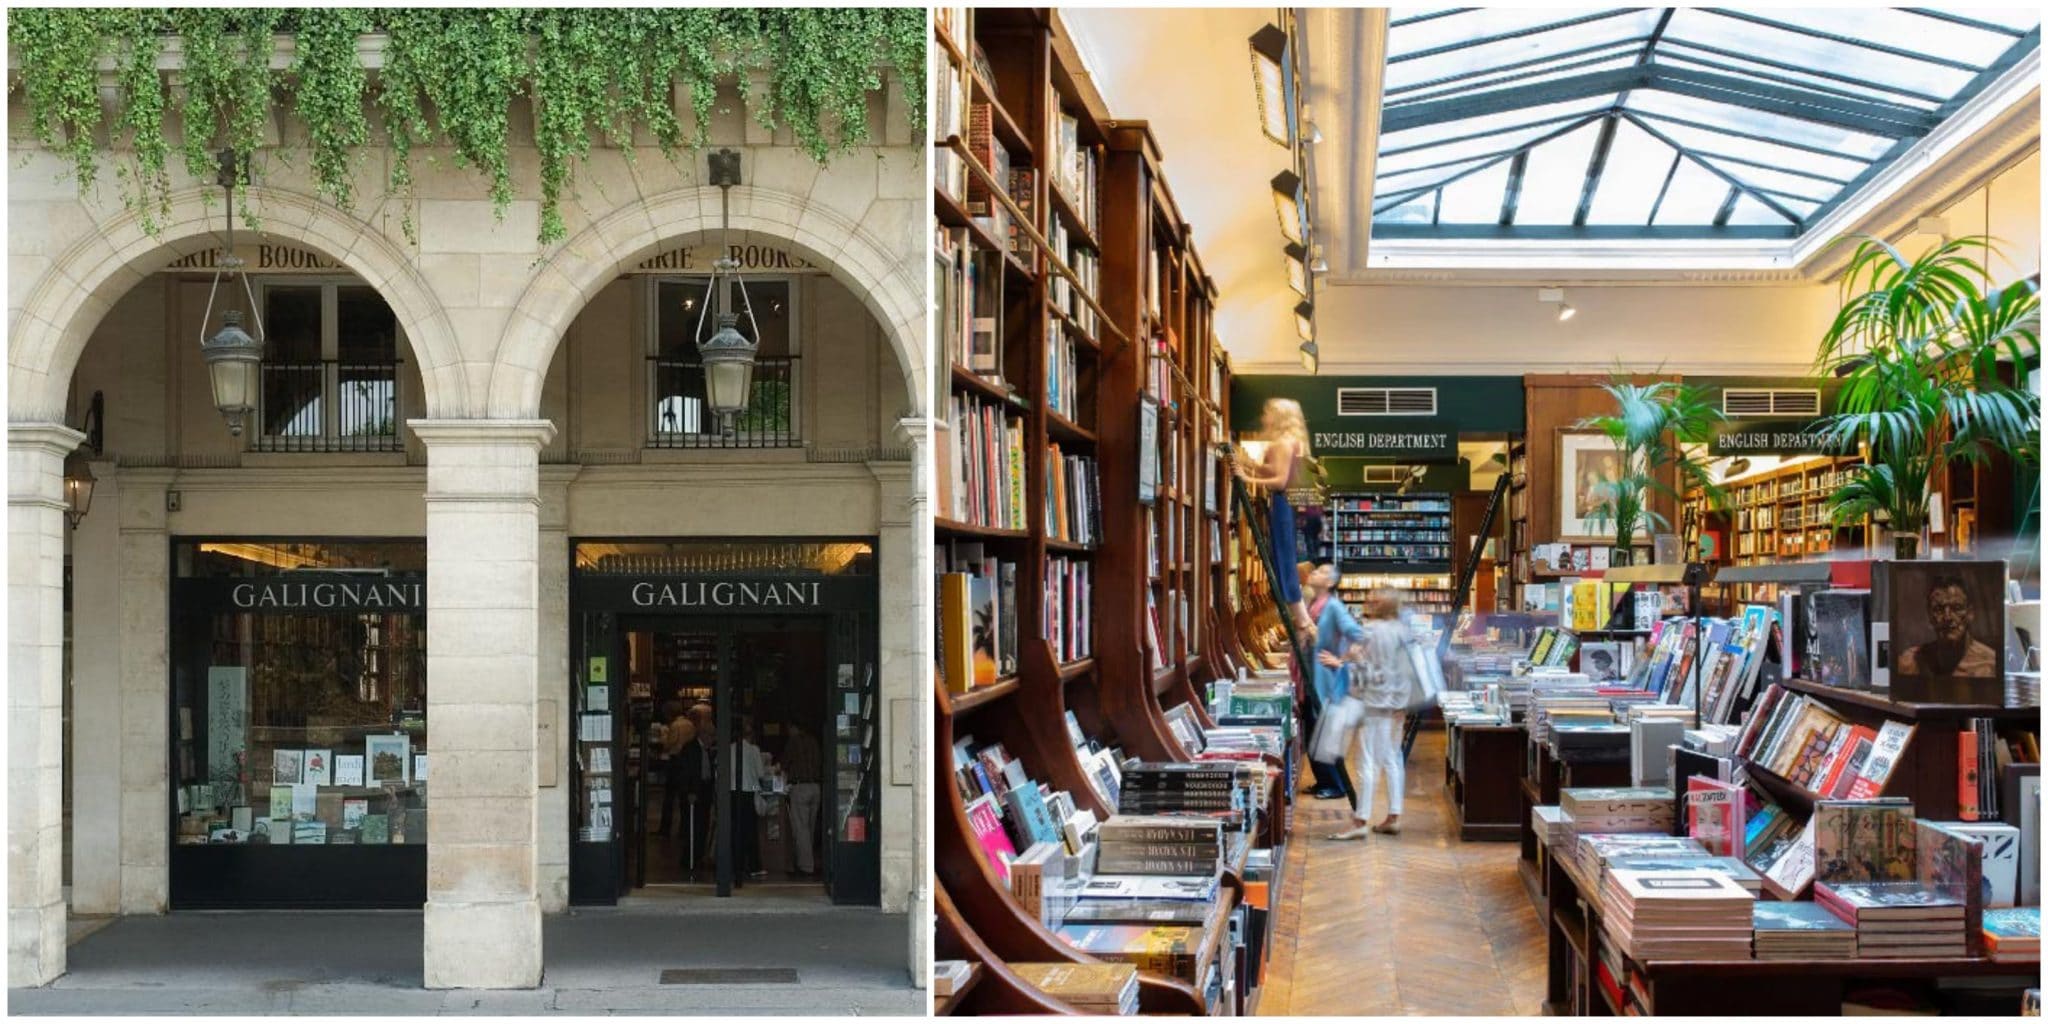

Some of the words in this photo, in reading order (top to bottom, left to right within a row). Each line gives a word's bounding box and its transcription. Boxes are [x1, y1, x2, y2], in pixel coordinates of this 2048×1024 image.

[1314, 433, 1365, 448] ENGLISH
[1369, 433, 1447, 448] DEPARTMENT
[1719, 433, 1768, 448] ENGLISH
[232, 583, 421, 607] GALIGNANI
[632, 582, 821, 606] GALIGNANI
